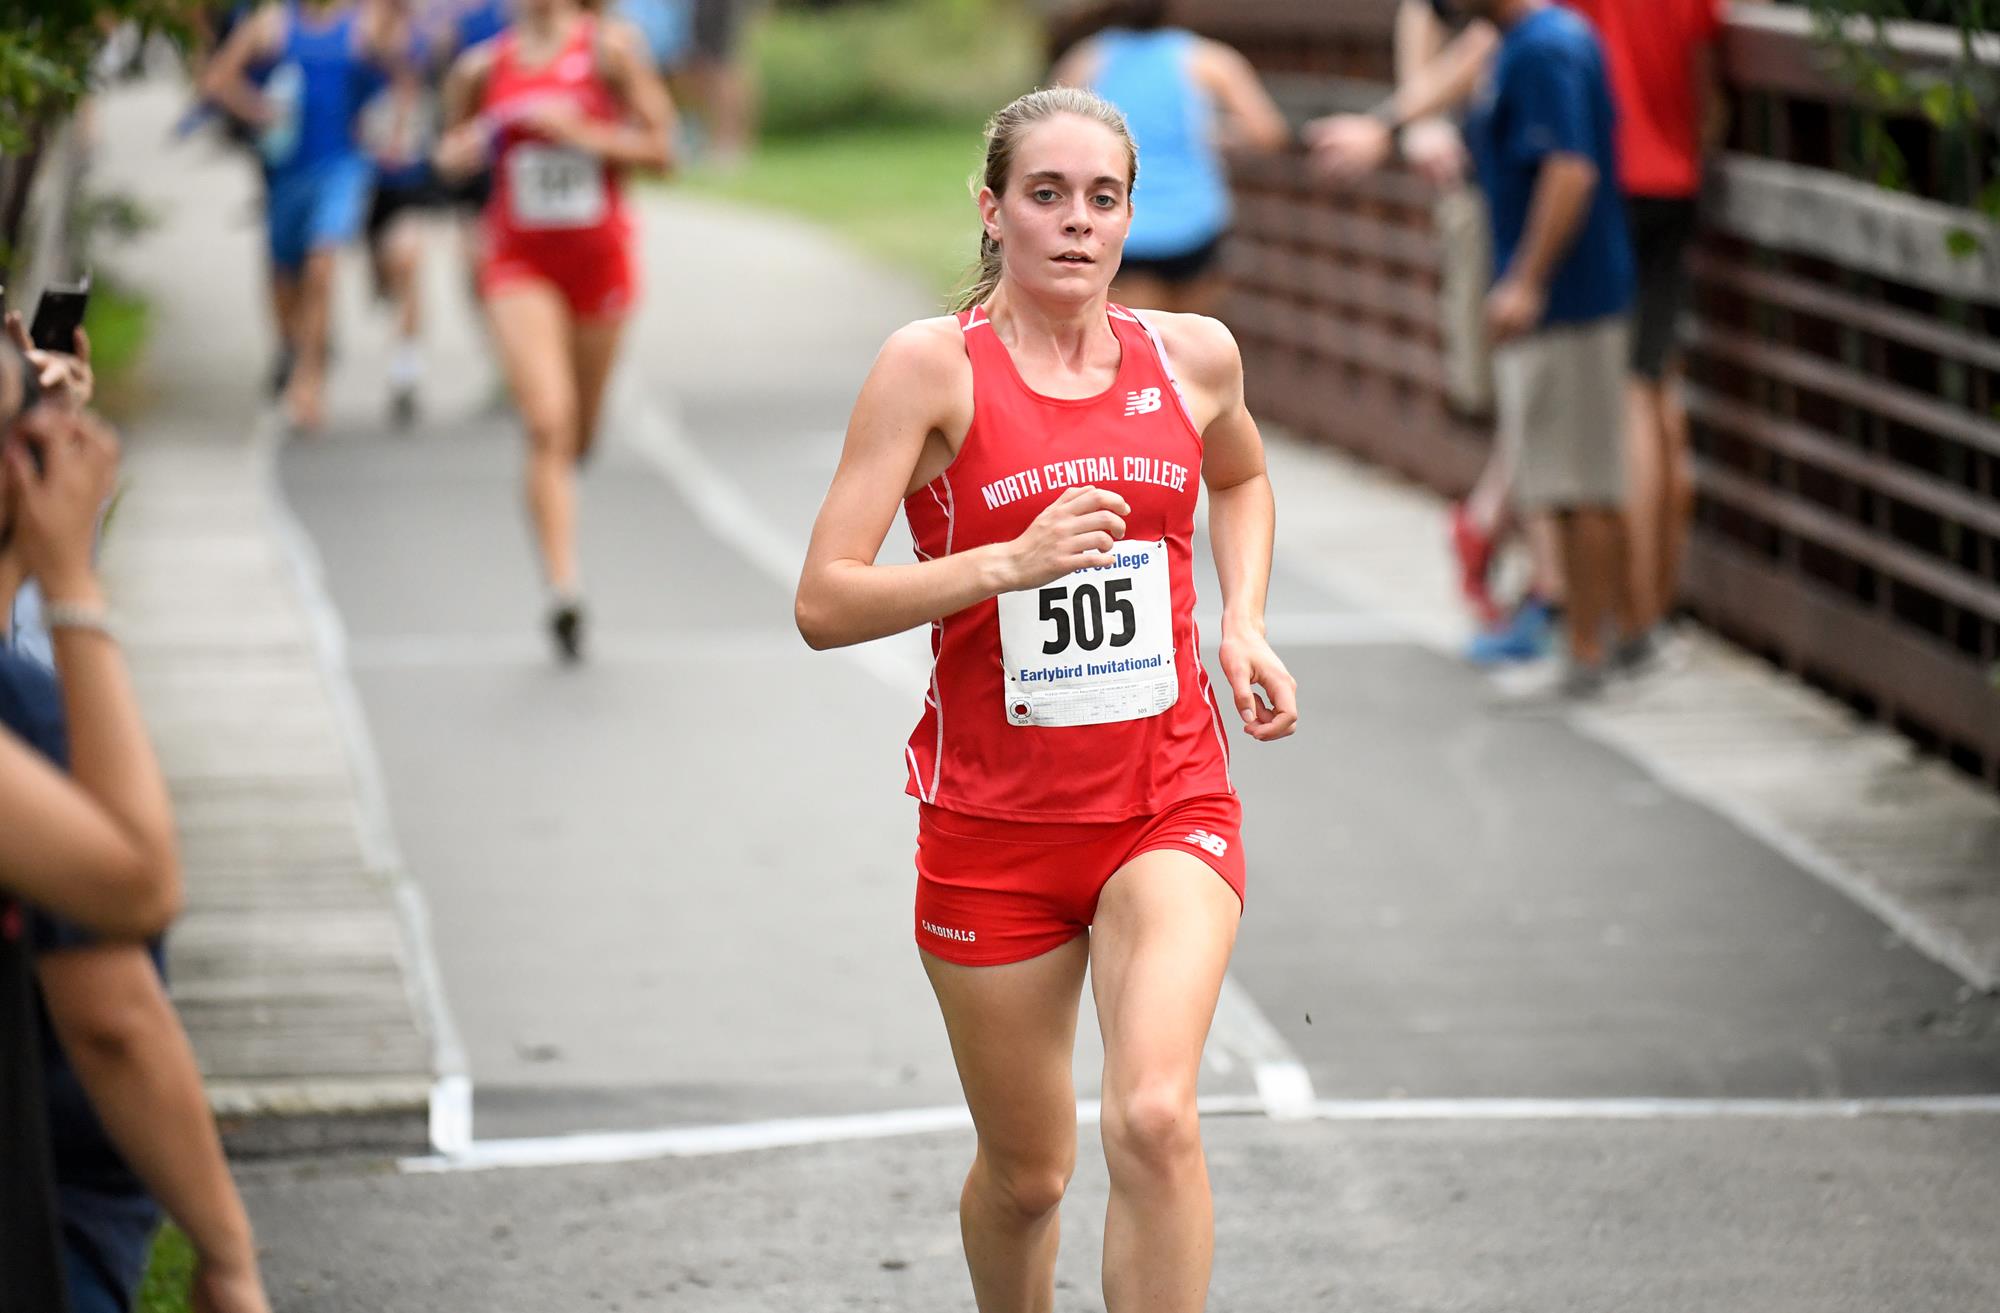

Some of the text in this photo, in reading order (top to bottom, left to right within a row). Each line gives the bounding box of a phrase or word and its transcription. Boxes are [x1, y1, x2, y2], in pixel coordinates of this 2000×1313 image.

[981, 456, 1188, 510] NORTH CENTRAL COLLEGE
[1094, 553, 1149, 571] llege
[1039, 577, 1136, 655] 505
[1020, 654, 1161, 682] Earlybird Invitational
[922, 919, 976, 942] CARDINALS
